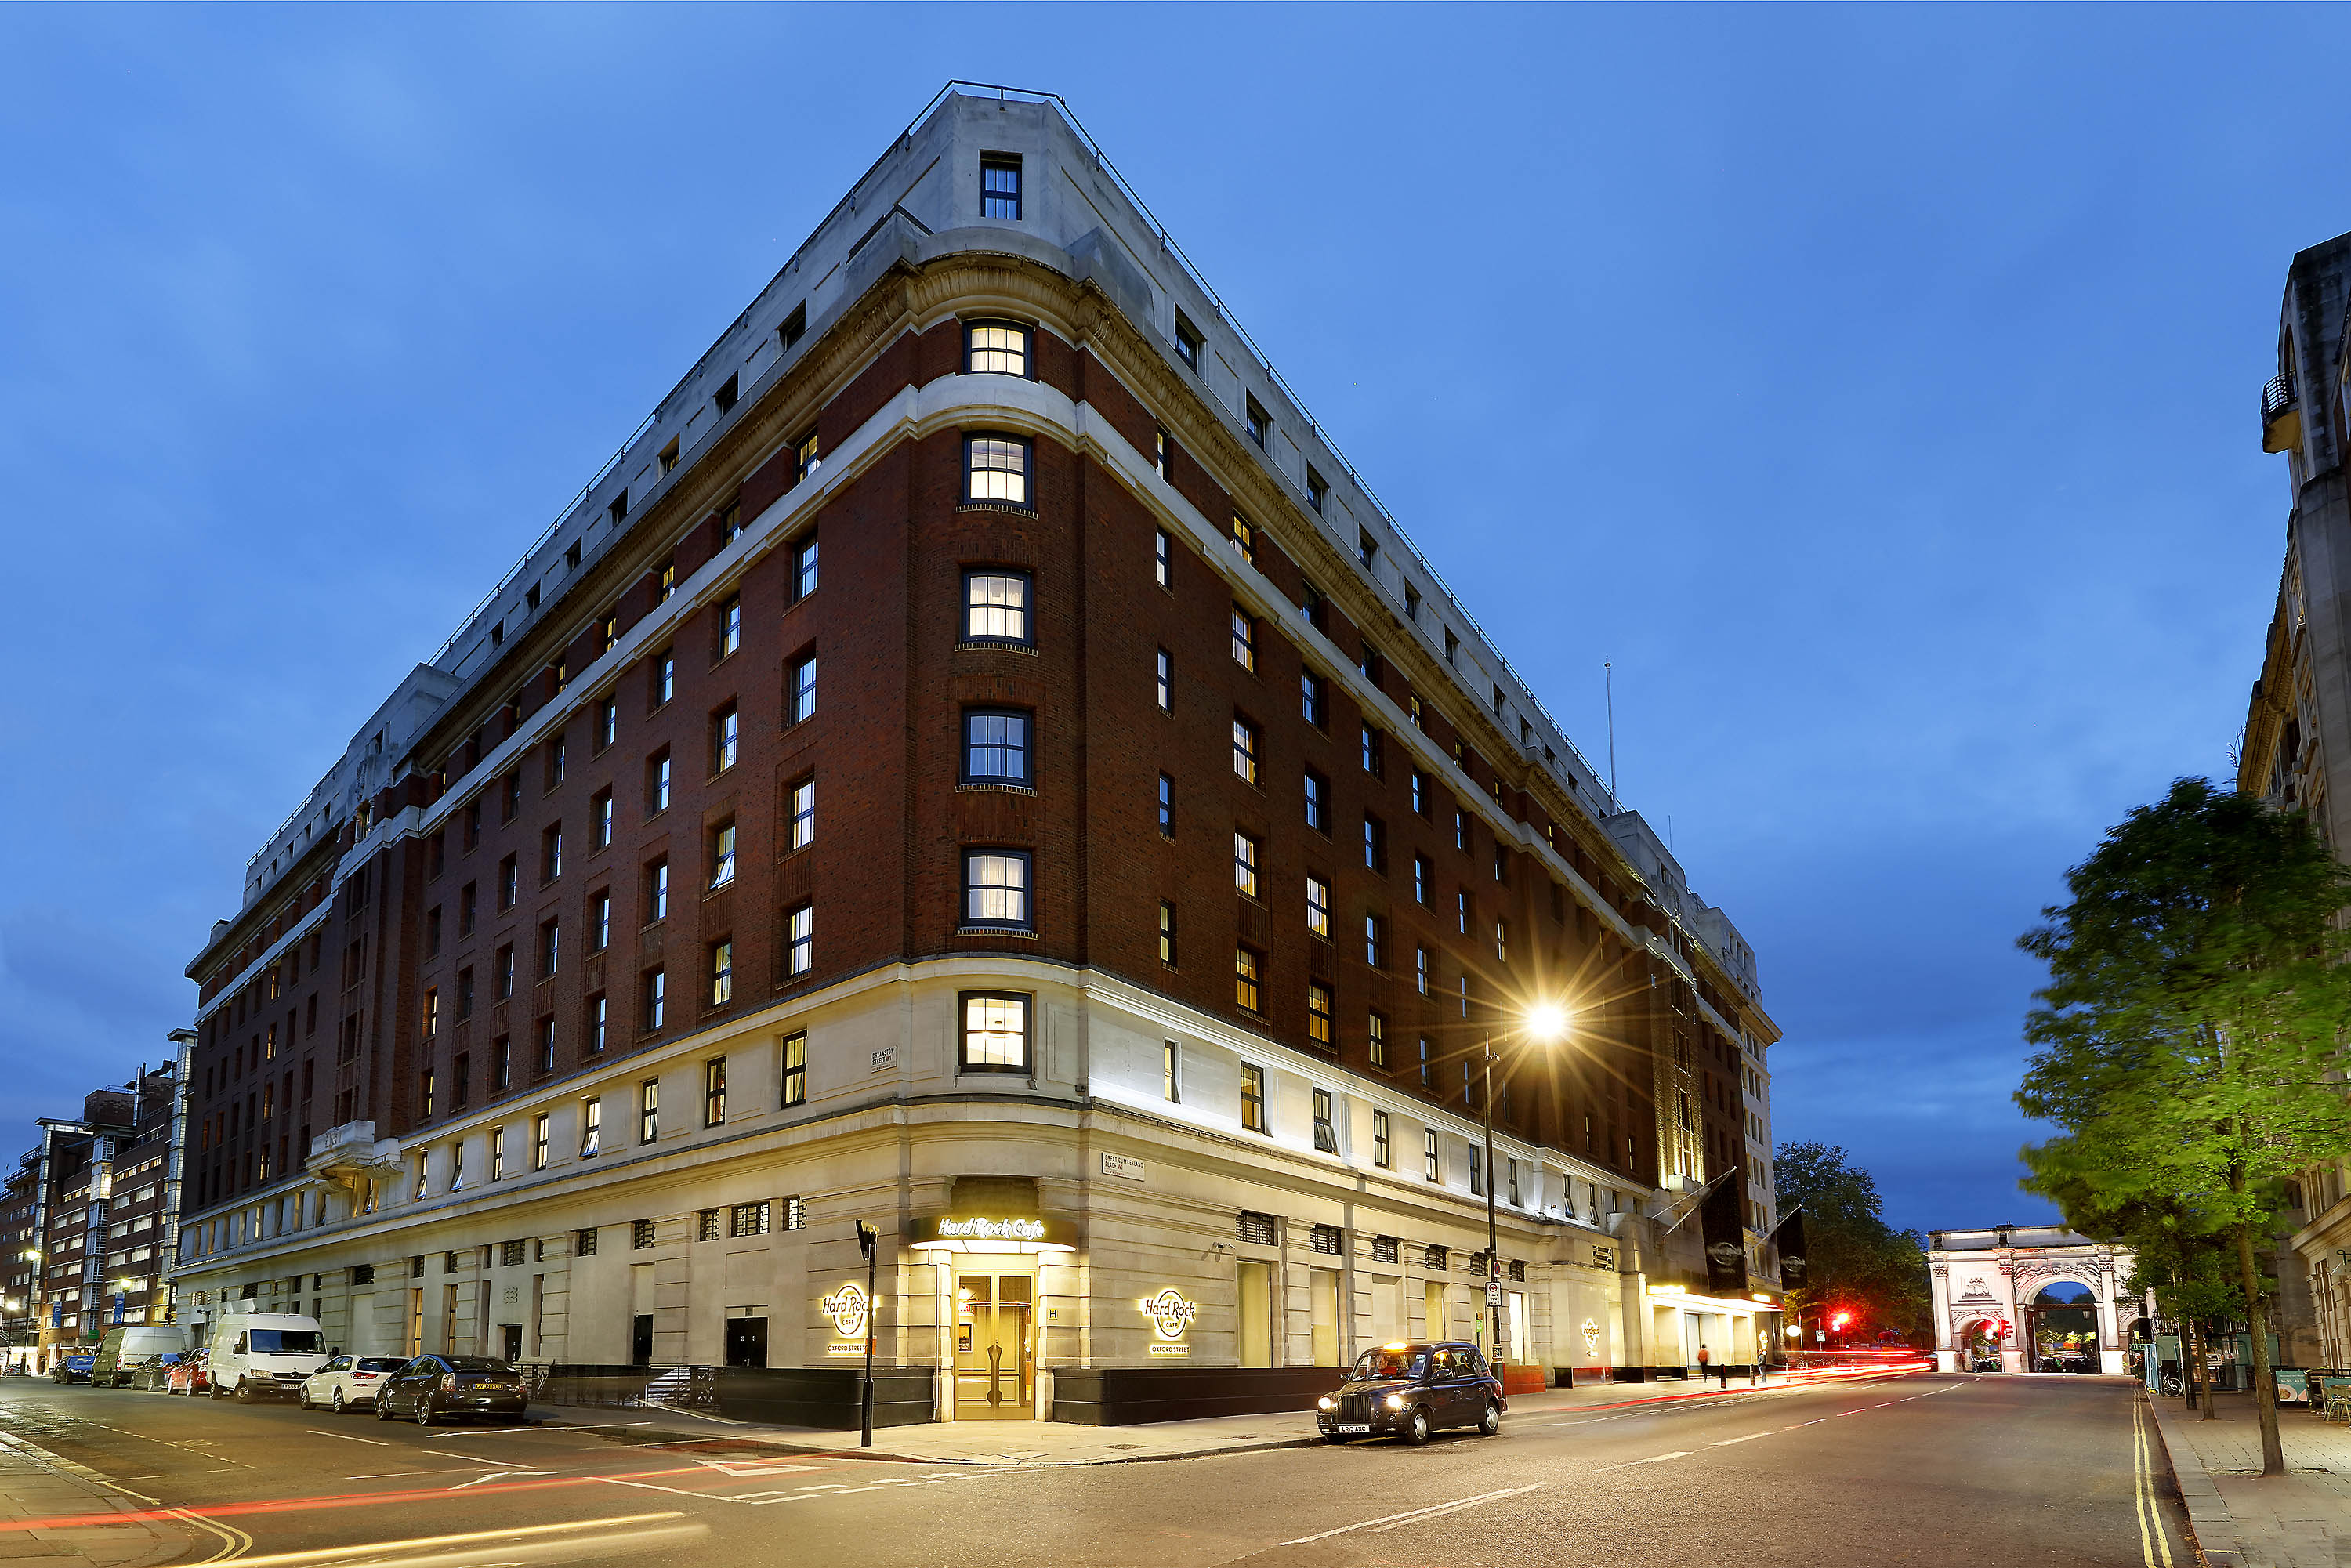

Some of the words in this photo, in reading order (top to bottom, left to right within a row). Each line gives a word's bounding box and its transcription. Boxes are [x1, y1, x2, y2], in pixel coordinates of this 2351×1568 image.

[872, 1048, 894, 1059] BRYANSTON
[872, 1056, 886, 1066] STREET
[1105, 1161, 1117, 1169] PLACE
[1118, 1157, 1144, 1168] CUMBERLAND
[937, 1217, 975, 1235] Hard
[974, 1217, 1012, 1239] Rock
[1012, 1218, 1045, 1240] Cafe
[822, 1297, 847, 1314] Hard
[849, 1296, 869, 1316] Roc
[1145, 1299, 1170, 1316] Hard
[1172, 1301, 1196, 1320] Rock
